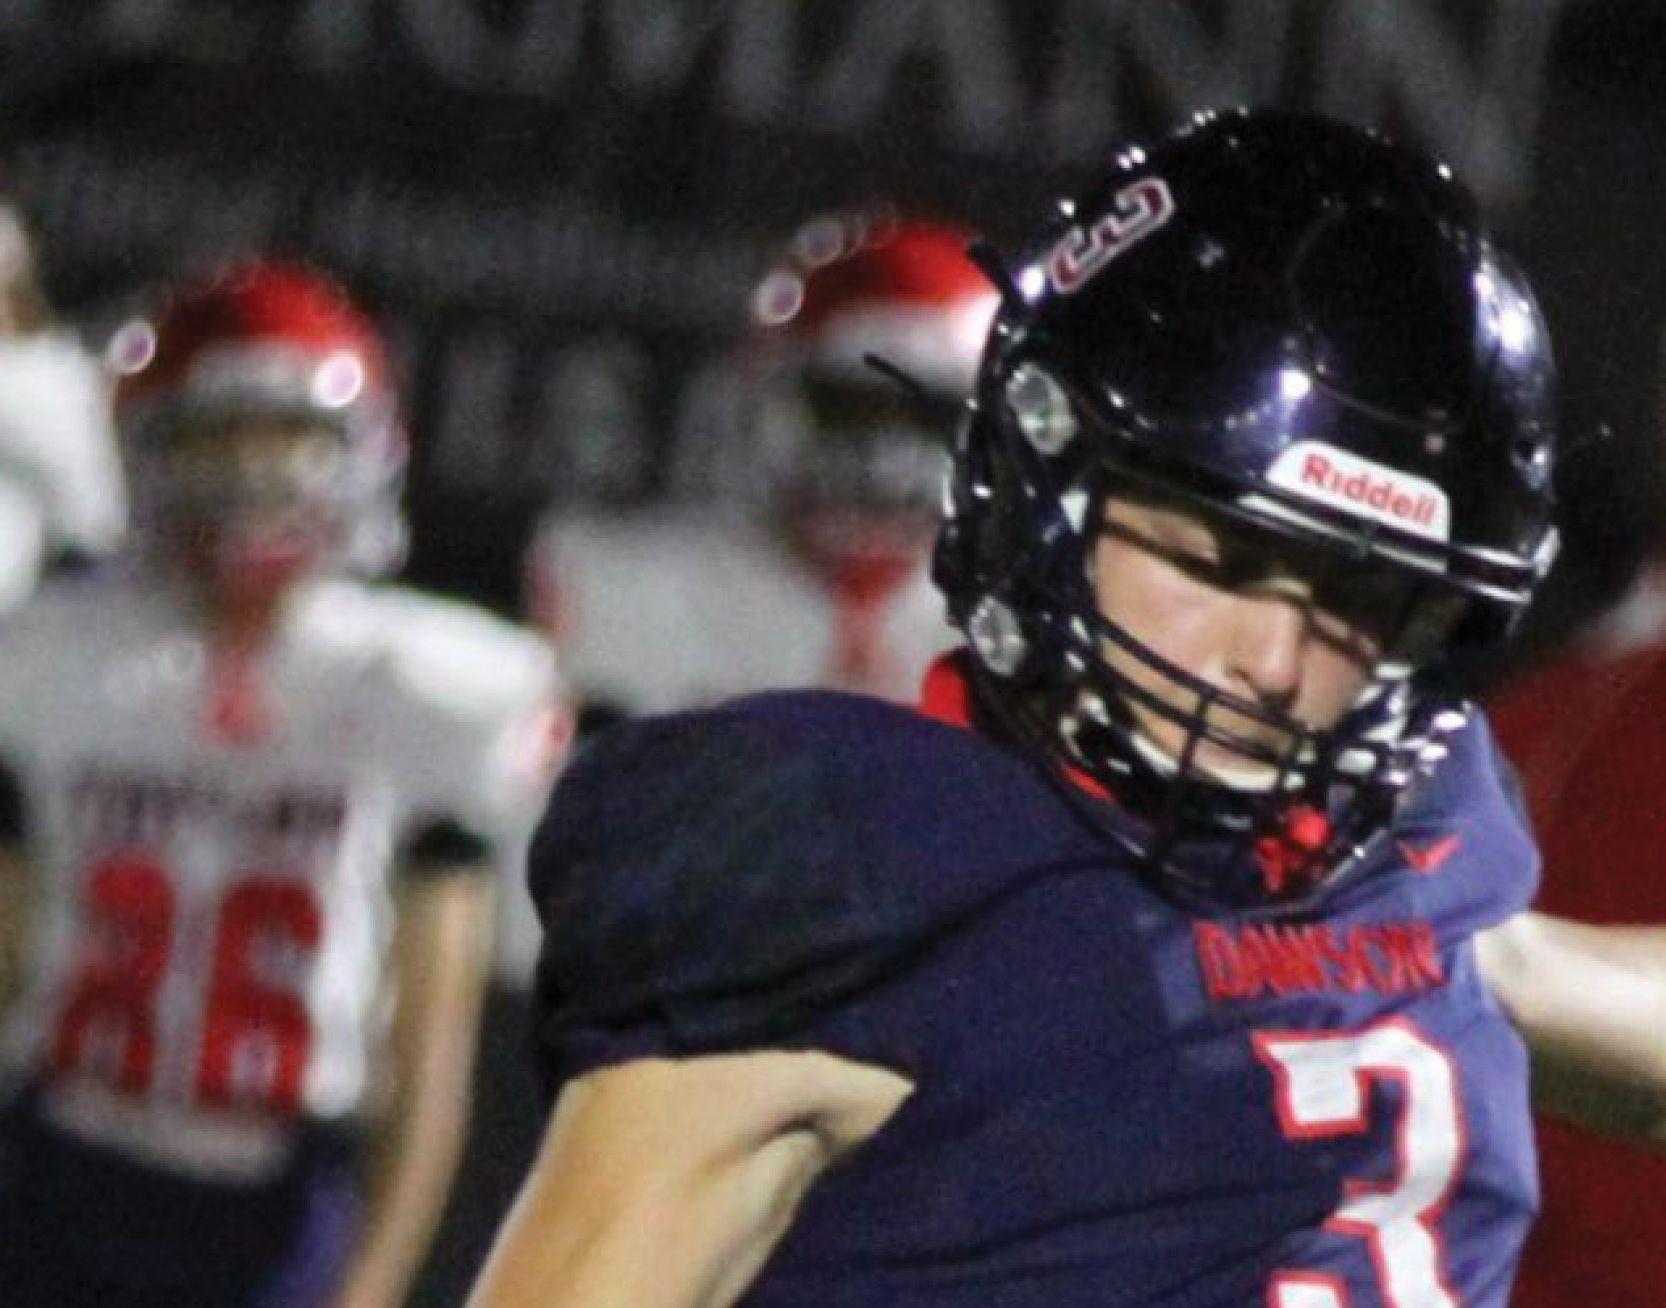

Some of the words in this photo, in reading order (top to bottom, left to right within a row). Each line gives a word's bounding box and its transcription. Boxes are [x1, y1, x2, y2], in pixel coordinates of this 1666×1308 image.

[1051, 177, 1175, 294] 3
[1300, 451, 1440, 527] Riddell
[1191, 917, 1449, 1001] DAWSON
